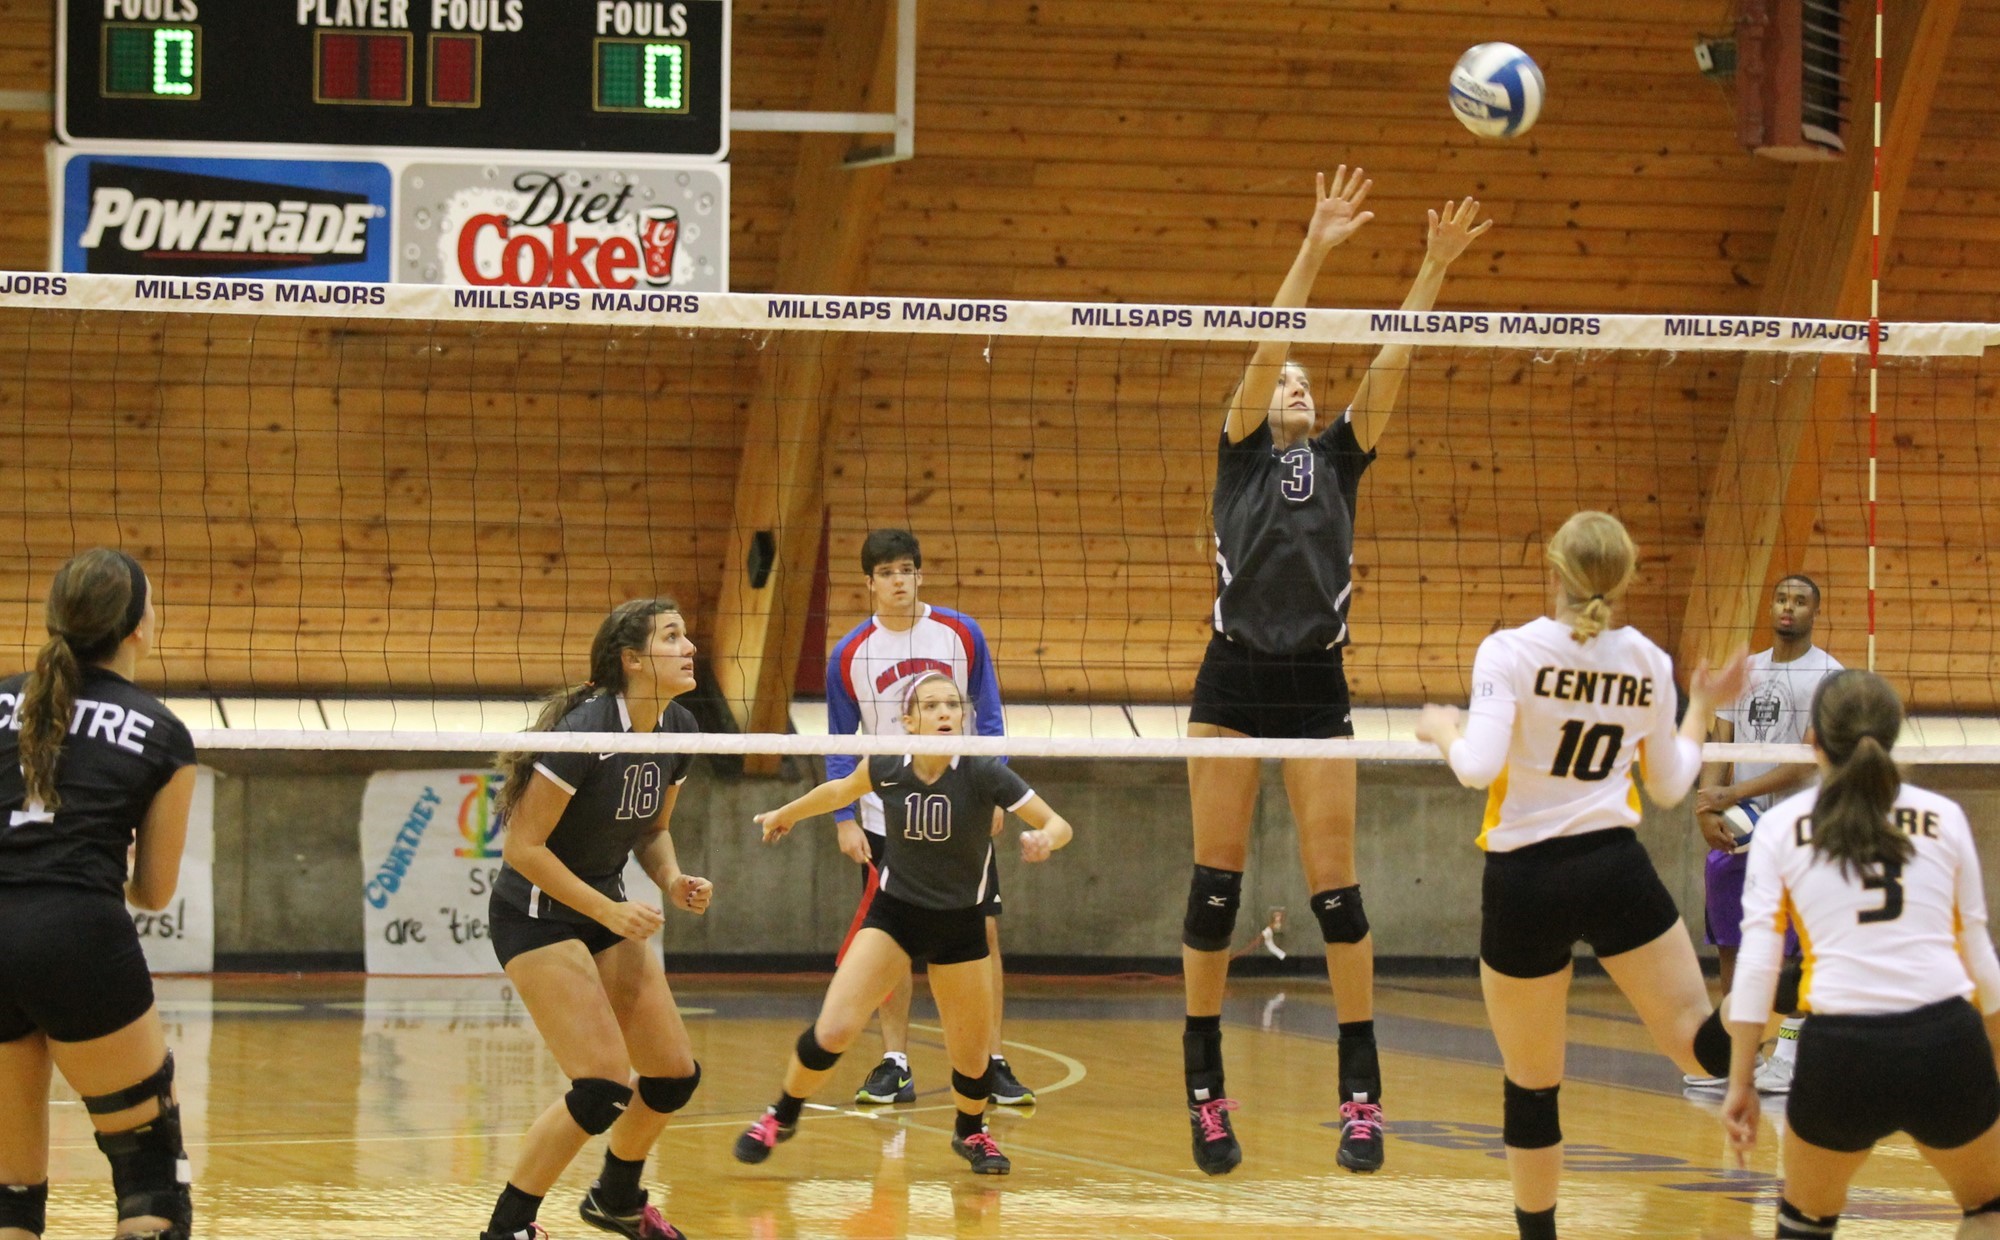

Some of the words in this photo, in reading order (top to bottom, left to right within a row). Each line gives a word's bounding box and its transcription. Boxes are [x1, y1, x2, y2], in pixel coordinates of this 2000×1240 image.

[104, 0, 199, 22] FOULS
[297, 0, 410, 27] PLAYER
[431, 0, 524, 32] FOULS
[597, 1, 688, 37] FOULS
[643, 43, 683, 109] 0
[513, 171, 634, 227] Diet
[457, 213, 640, 290] Coke
[0, 275, 68, 296] JORS
[135, 279, 264, 302] MILLSAPS
[275, 283, 386, 305] MAJORS
[454, 289, 581, 311] MILLSAPS
[591, 292, 700, 314] MAJORS
[767, 300, 892, 320] MILLSAPS
[902, 302, 1009, 323] MAJORS
[1071, 307, 1193, 328] MILLSAPS
[1203, 309, 1307, 330] MAJORS
[1370, 313, 1489, 334] MILLSAPS
[1499, 316, 1601, 336] MAJORS
[1664, 318, 1781, 338] MILLSAPS
[1280, 448, 1314, 502] 3
[1534, 666, 1654, 707] CENTRE
[1550, 718, 1625, 782] 10
[615, 761, 661, 820] 18
[904, 792, 952, 842] 10
[1856, 856, 1904, 925] 3
[385, 918, 427, 945] are
